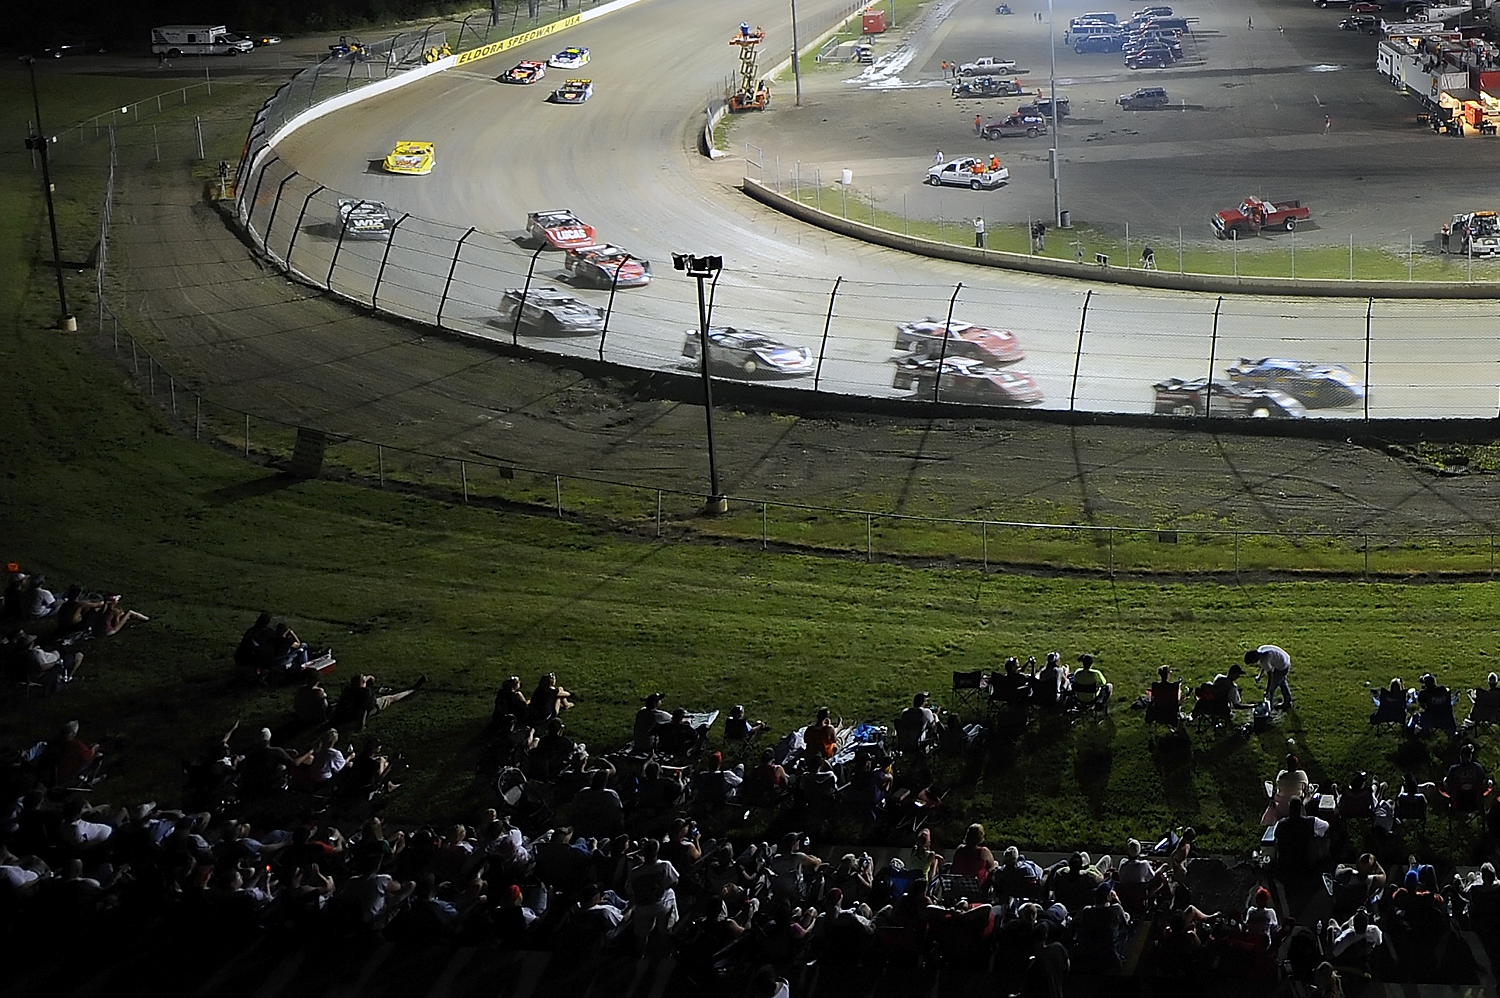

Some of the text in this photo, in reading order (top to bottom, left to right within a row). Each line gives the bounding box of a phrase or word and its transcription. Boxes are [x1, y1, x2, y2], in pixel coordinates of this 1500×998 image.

[459, 14, 581, 63] ELDORA SPEEDWAY USA
[556, 229, 587, 240] LUCAS
